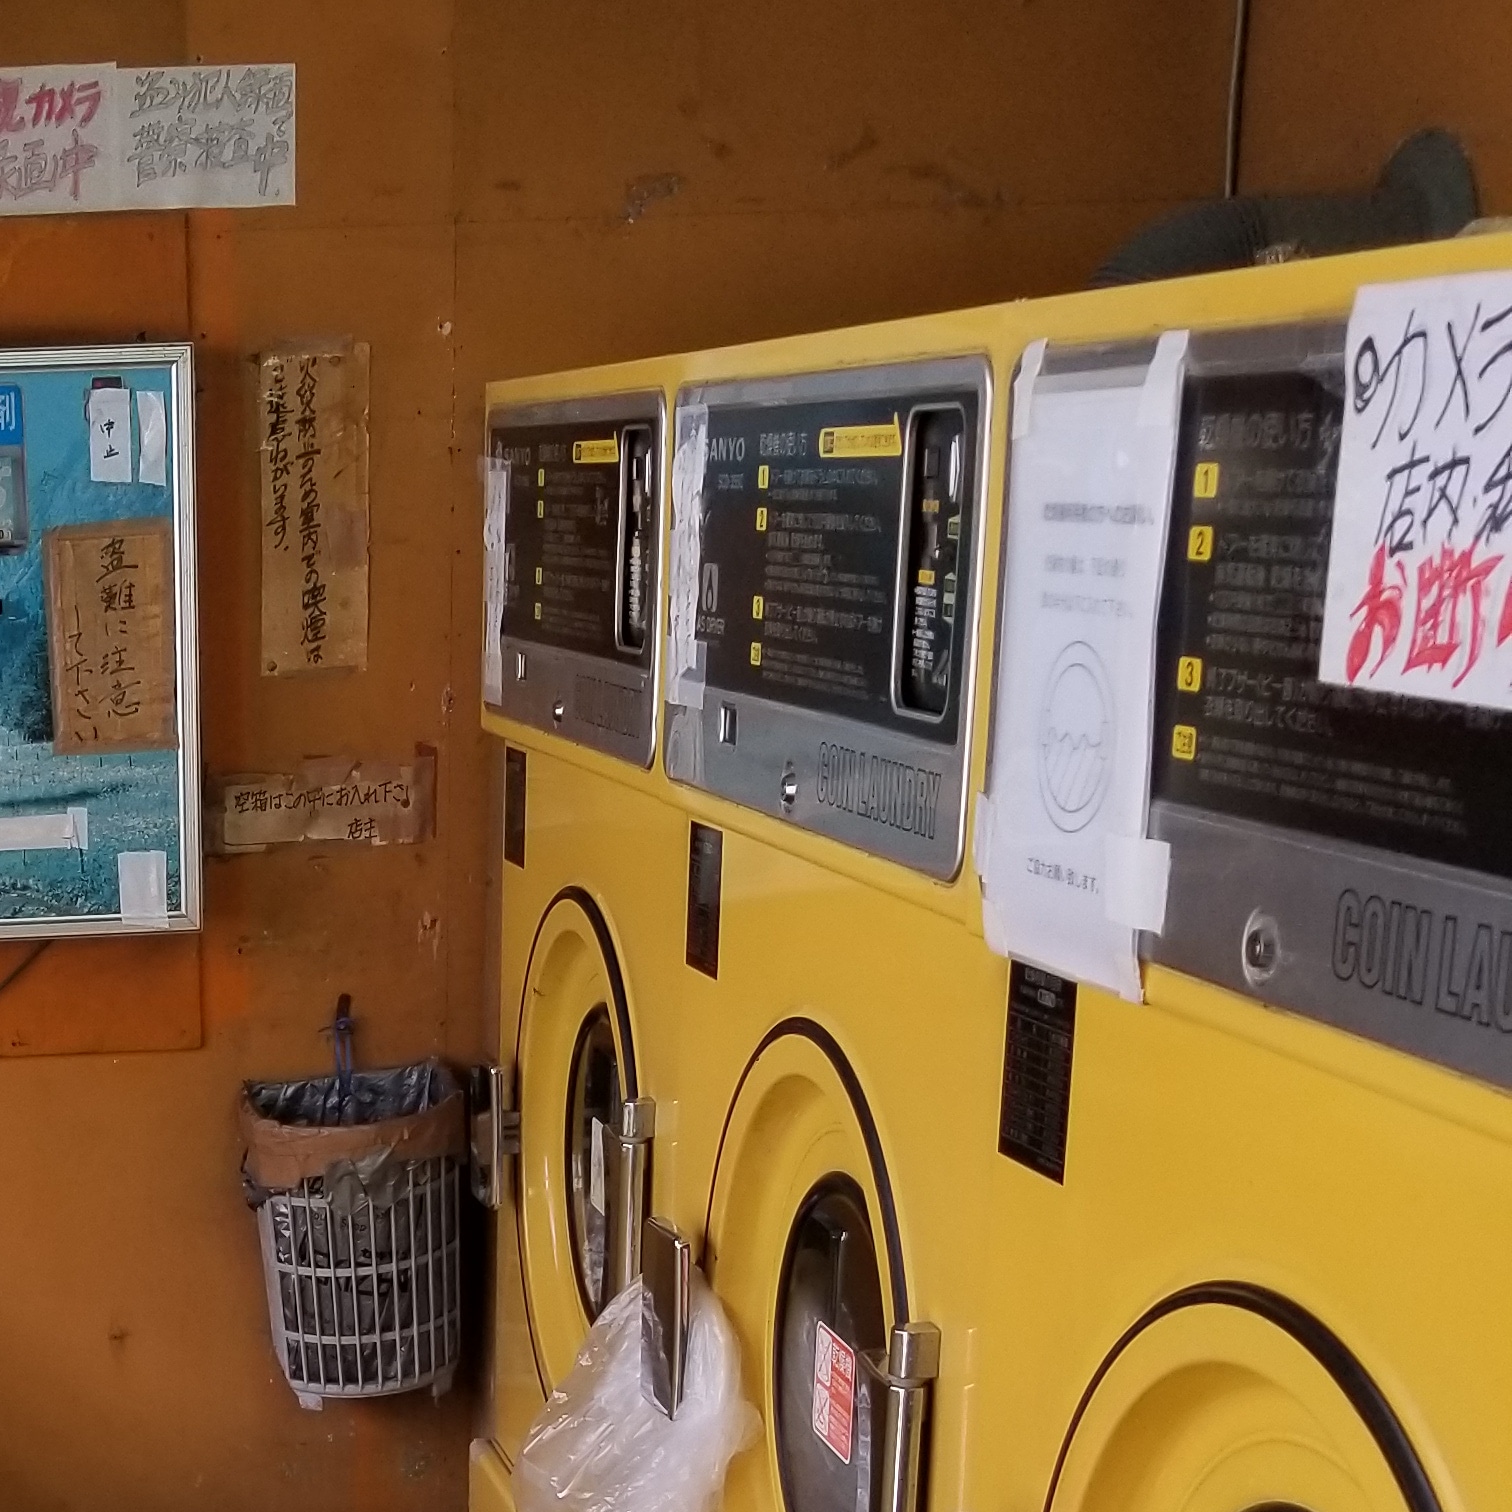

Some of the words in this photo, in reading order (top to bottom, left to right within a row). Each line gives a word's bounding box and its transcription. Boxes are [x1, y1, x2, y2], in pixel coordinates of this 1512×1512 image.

[98, 418, 121, 460] 中止
[65, 604, 99, 743] して下さい
[95, 536, 141, 718] 盗難に注意
[346, 817, 379, 840] 店主
[816, 741, 857, 814] COIN
[857, 752, 942, 841] LAUNDRY
[1332, 888, 1433, 1006] COIN
